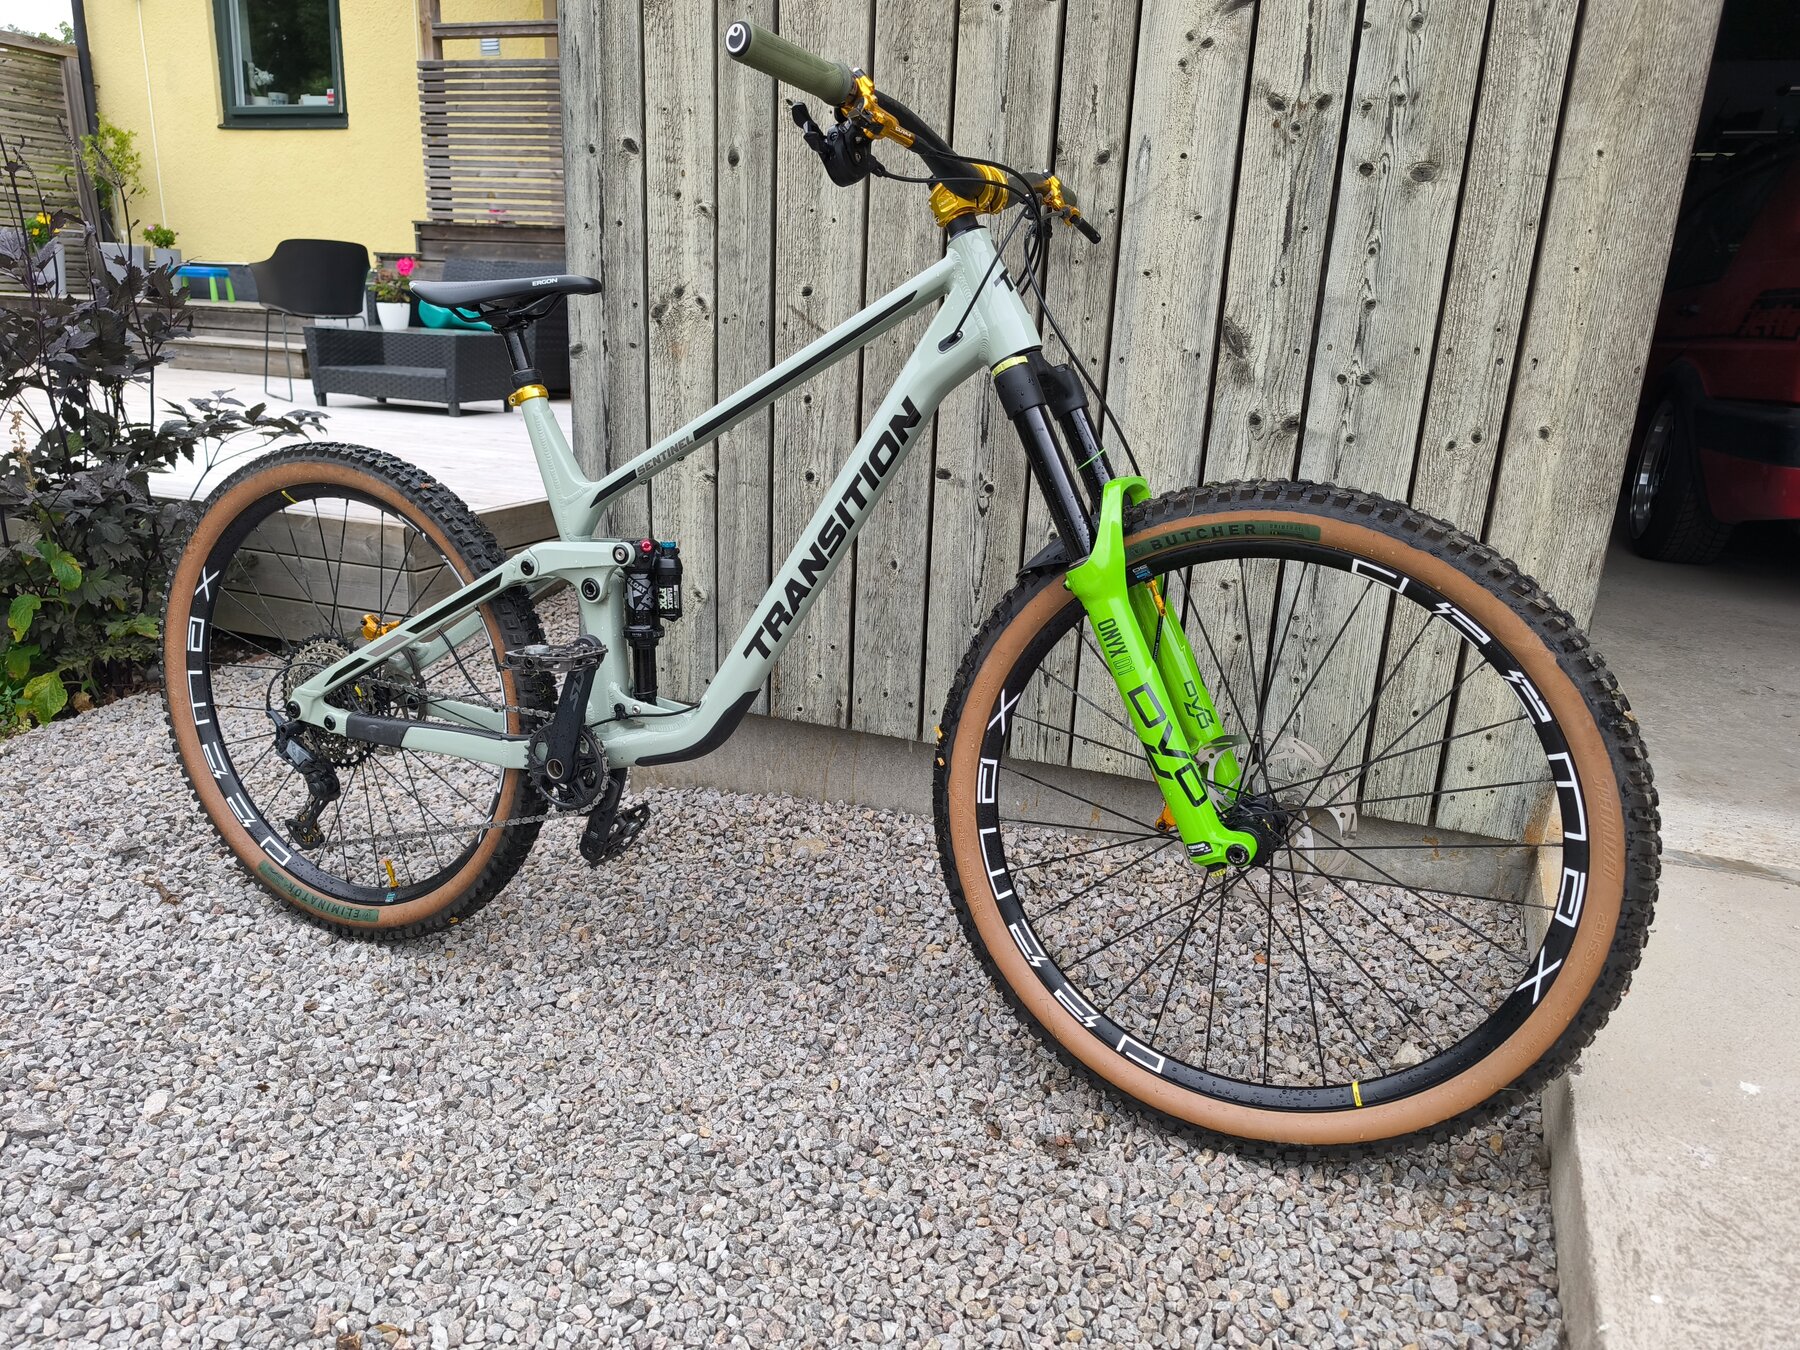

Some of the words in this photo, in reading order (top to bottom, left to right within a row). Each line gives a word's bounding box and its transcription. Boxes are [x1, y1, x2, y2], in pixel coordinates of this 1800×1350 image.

[532, 277, 558, 287] ERGON
[637, 433, 694, 476] SENTINEL
[743, 395, 922, 660] TRANSITION
[1149, 523, 1257, 550] BUTCHER
[627, 577, 647, 594] FLOAT
[658, 587, 667, 610] FOX
[1097, 617, 1128, 658] ONYX
[1114, 653, 1136, 676] D1
[1184, 679, 1214, 730] DVO
[1127, 682, 1209, 808] DVO
[1591, 775, 1617, 881] SPECIALIZED
[285, 881, 360, 919] ELIMINATOR
